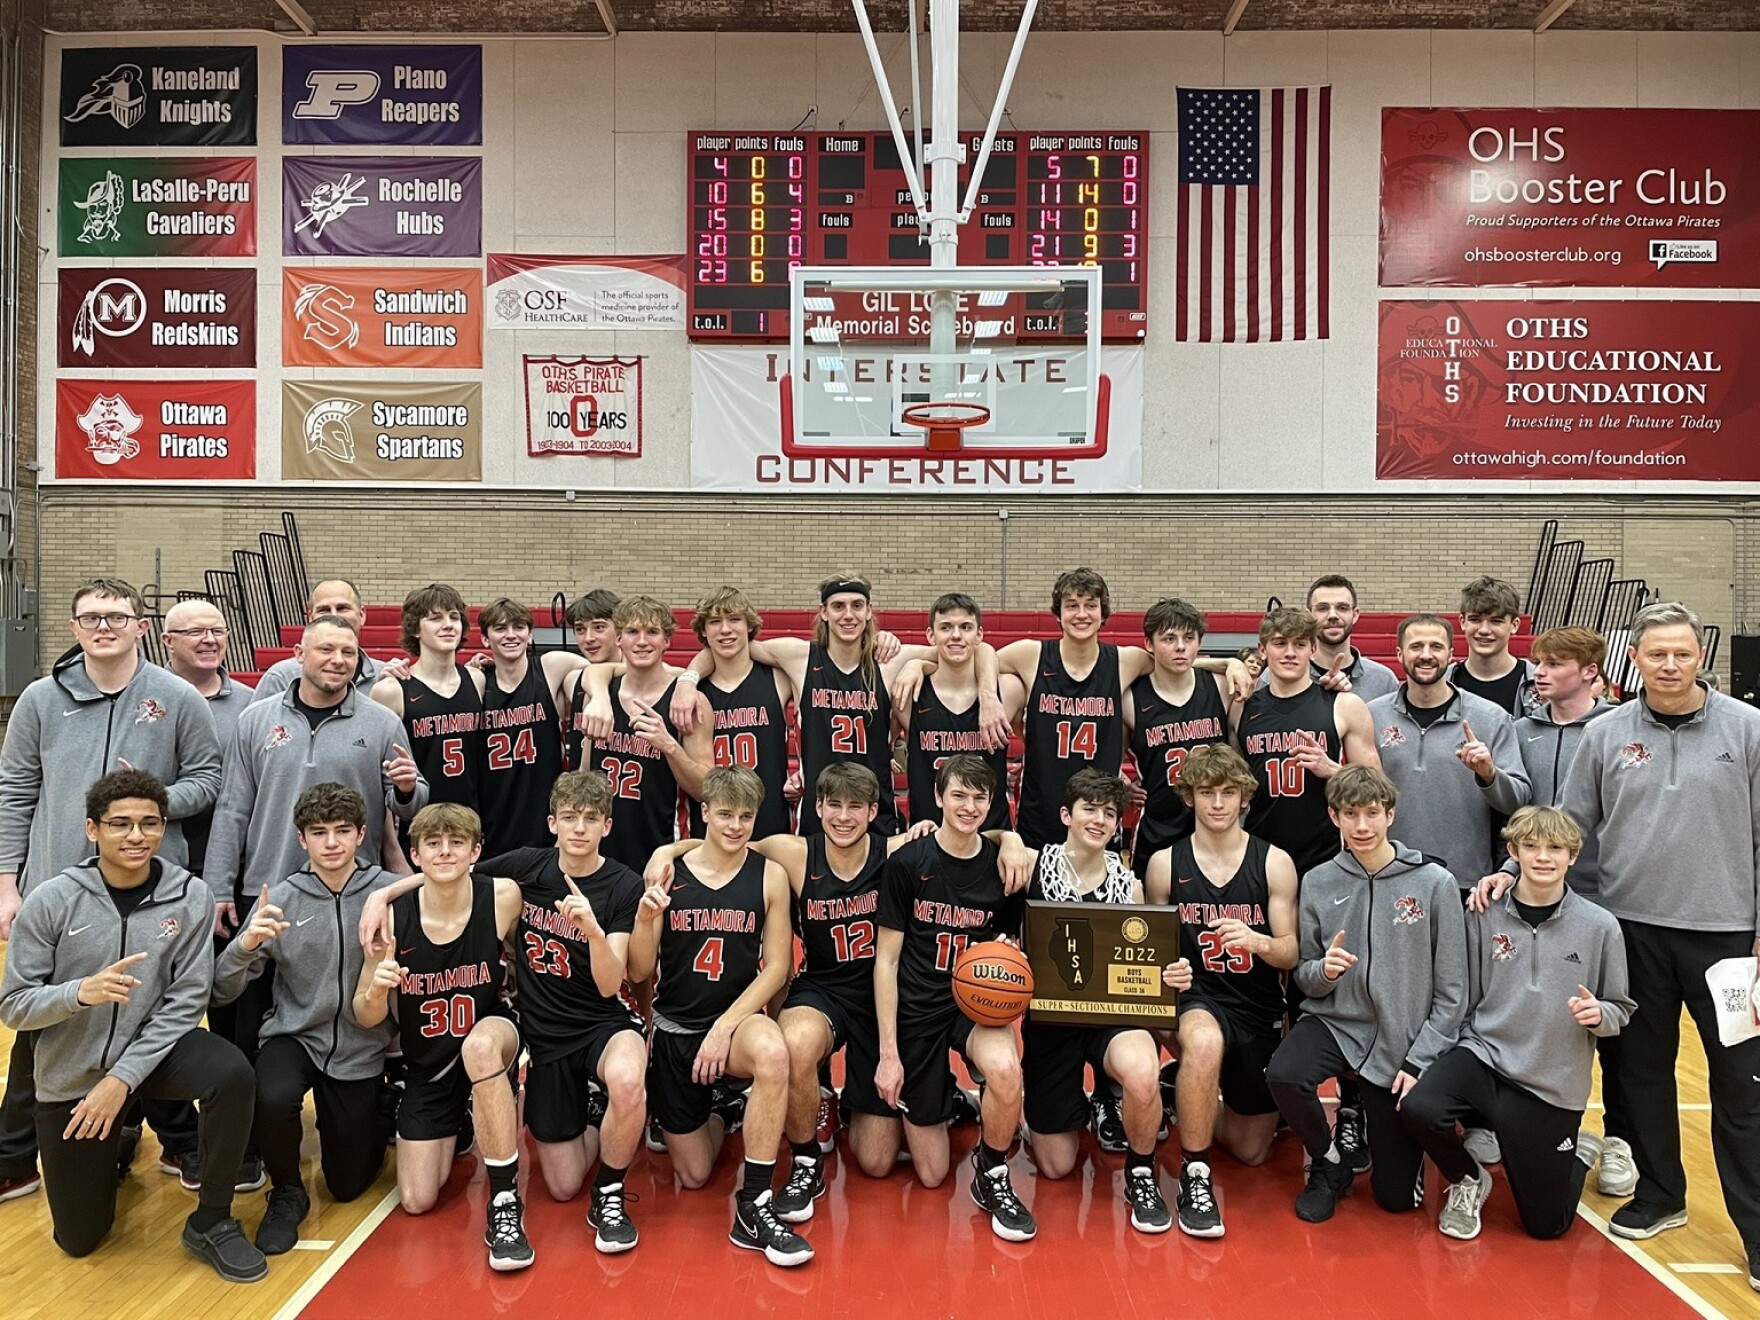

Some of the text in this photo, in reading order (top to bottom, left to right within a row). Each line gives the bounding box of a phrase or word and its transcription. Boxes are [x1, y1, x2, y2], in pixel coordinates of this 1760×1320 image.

[152, 67, 240, 90] Kaneland
[394, 66, 447, 89] Plano
[292, 70, 380, 119] P
[160, 100, 232, 124] Knights
[381, 99, 460, 124] Reapers
[697, 137, 804, 151] player points fouls
[826, 137, 859, 152] Home
[972, 137, 1014, 151] Gsts
[1030, 136, 1138, 151] player points fouls
[1468, 127, 1565, 163] OHS
[714, 157, 728, 177] 4
[751, 156, 765, 179] 0
[789, 156, 802, 179] 0
[1047, 156, 1061, 178] 5
[1086, 156, 1099, 178] 7
[1123, 155, 1137, 178] 0
[132, 179, 250, 202] LaSalle-Peru
[378, 179, 462, 202] Rochelle
[708, 182, 727, 204] 10
[751, 182, 765, 205] 6
[789, 183, 802, 203] 4
[1041, 183, 1061, 204] 11
[1078, 183, 1099, 204] 14
[1123, 181, 1137, 204] 0
[1470, 168, 1727, 205] Booster Club
[147, 212, 236, 235] Cavaliers
[396, 212, 444, 235] Hubs
[708, 208, 727, 231] 15
[751, 208, 764, 231] 8
[790, 208, 802, 231] 3
[823, 214, 850, 227] fouls
[897, 213, 920, 227] play
[984, 214, 1011, 226] fouls
[1040, 209, 1060, 230] 14
[1084, 208, 1098, 231] 0
[1466, 214, 1721, 229] Proud Supporters of the Ottawa Pirates
[699, 234, 727, 257] 20
[751, 234, 764, 257] 0
[788, 234, 802, 257] 0
[1031, 234, 1060, 257] 21
[1084, 234, 1098, 257] 9
[1123, 234, 1136, 257] 3
[1464, 247, 1622, 266] ohsboosterclub.org
[1669, 249, 1713, 259] Facebook
[699, 260, 727, 282] 23
[751, 260, 764, 282] 6
[164, 290, 226, 313] Morris
[374, 289, 467, 314] Sandwich
[524, 290, 568, 310] OSF
[601, 302, 680, 312] medicine provider of
[602, 290, 668, 301] The official sports
[862, 291, 969, 312] GIL LOE
[100, 293, 137, 322] M
[602, 314, 614, 322] the
[152, 322, 239, 347] Redskins
[694, 316, 725, 330] t.o.l.
[816, 316, 1015, 335] Memorial Scebd
[1506, 318, 1588, 339] OTHS
[384, 323, 457, 347] Indians
[1506, 351, 1722, 371] EDUCATIONAL
[584, 367, 625, 380] PIRATE
[546, 380, 624, 394] BASKETBALL
[1505, 384, 1707, 404] FOUNDATION
[161, 401, 228, 426] Ottawa
[372, 401, 468, 427] Sycamore
[547, 411, 627, 430] 100 YEARS
[1504, 414, 1722, 433] Investing in the Future Today
[159, 434, 229, 459] Pirates
[376, 435, 464, 460] Spartans
[756, 455, 1076, 485] CONFERENCE
[1453, 450, 1686, 468] ottawahigh.com/foundation
[1039, 693, 1114, 717] METAMORA
[713, 707, 769, 728] TAMORA
[831, 714, 867, 754] 21
[920, 731, 997, 751] METAMO
[1057, 721, 1097, 760] 14
[1146, 717, 1223, 747] METAMORA
[443, 738, 465, 777] 5
[487, 728, 537, 771] 24
[713, 732, 758, 771] 40
[1165, 744, 1211, 786] 2
[602, 757, 643, 801] 32
[1265, 758, 1305, 797] 10
[807, 890, 879, 920] METAMOR
[1179, 903, 1265, 925] METAMORA
[521, 901, 588, 943] ETAMORA
[670, 909, 756, 933] METAMORA
[830, 920, 875, 963] 12
[935, 932, 968, 972] 11
[1197, 931, 1253, 973] 25
[525, 931, 572, 978] 23
[693, 937, 724, 982] 4
[1114, 946, 1155, 962] 2022
[401, 961, 492, 995] METAMORA
[973, 964, 1026, 986] Wilson
[1117, 976, 1152, 985] BASKETBALL
[1127, 968, 1142, 976] BOYS
[971, 993, 1023, 1010] EVOLUTION
[1119, 1004, 1168, 1015] CHAMPIONS
[420, 993, 475, 1038] 30
